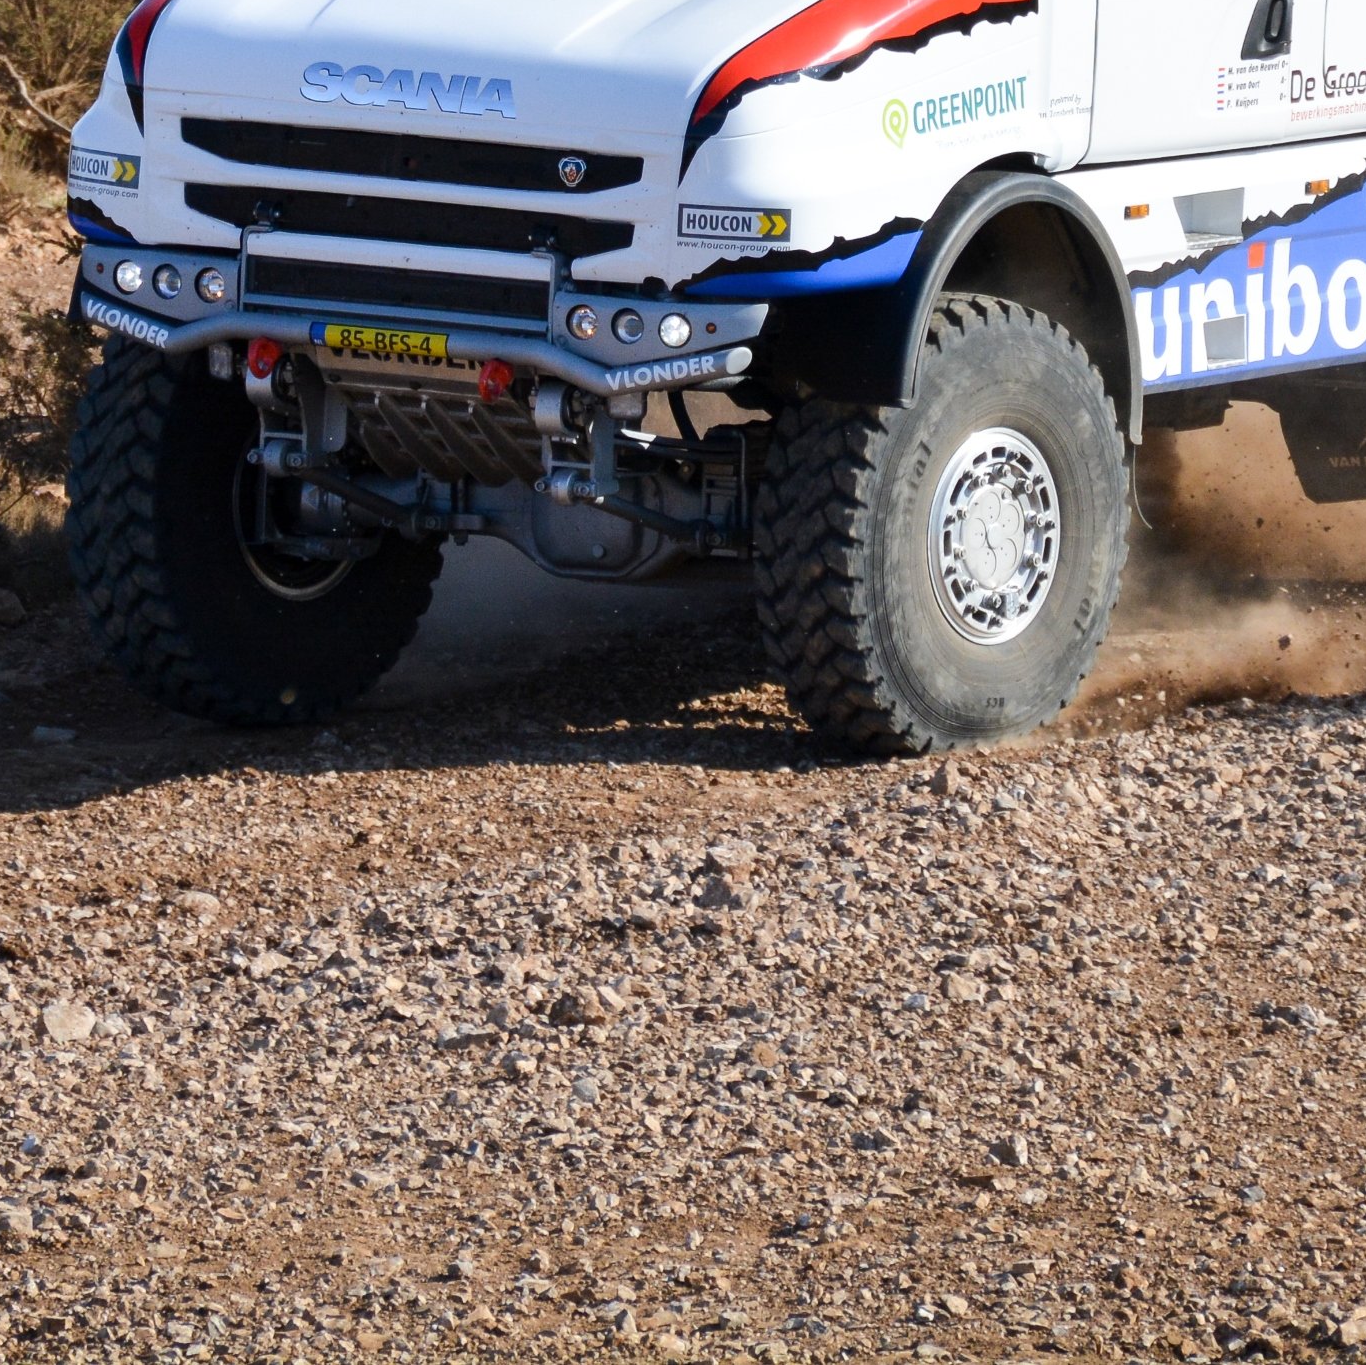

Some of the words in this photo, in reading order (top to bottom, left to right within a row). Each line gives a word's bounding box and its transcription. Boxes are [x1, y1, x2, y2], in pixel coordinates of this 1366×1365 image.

[299, 60, 517, 120] SCANIA
[1290, 69, 1316, 104] De
[913, 75, 1027, 135] GREENPOINT
[71, 153, 109, 176] HOUCON
[686, 212, 752, 233] HOUCON
[676, 239, 791, 253] www.houcon-group.com
[86, 299, 169, 349] VLONDER
[339, 328, 433, 355] 85-BFS-4
[605, 354, 716, 391] VLONDER
[1329, 456, 1361, 468] VAN
